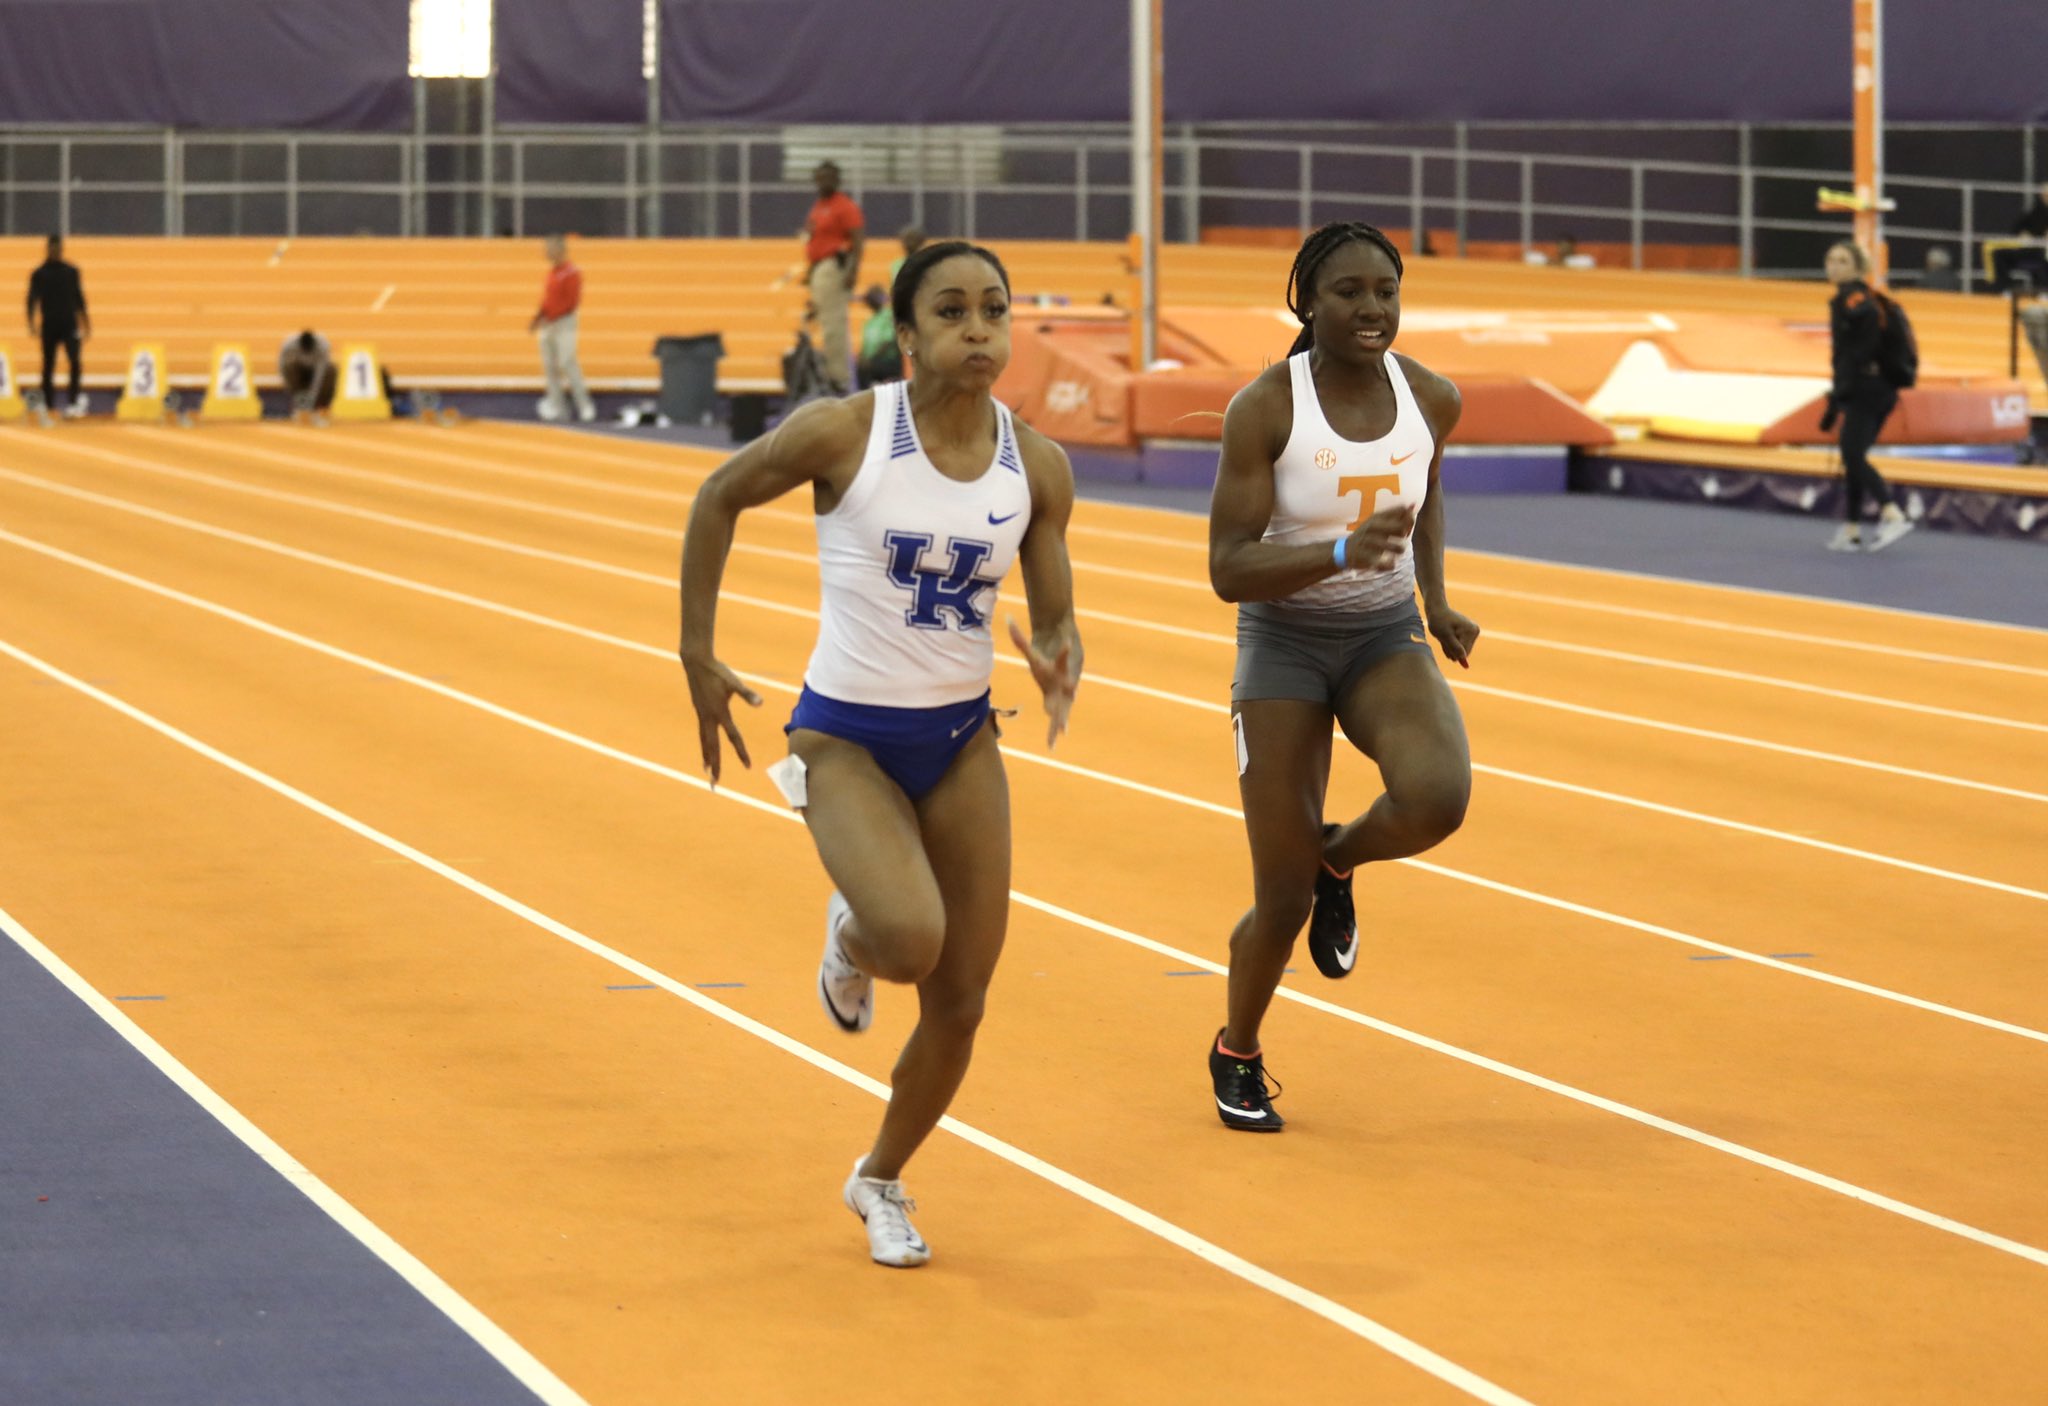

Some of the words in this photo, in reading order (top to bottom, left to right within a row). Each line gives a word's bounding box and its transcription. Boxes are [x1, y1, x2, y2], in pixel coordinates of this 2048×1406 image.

[135, 355, 155, 394] 3
[222, 355, 243, 392] 2
[354, 362, 367, 393] 1
[1315, 448, 1336, 470] SEC
[1337, 474, 1400, 531] T
[884, 529, 1000, 631] UK
